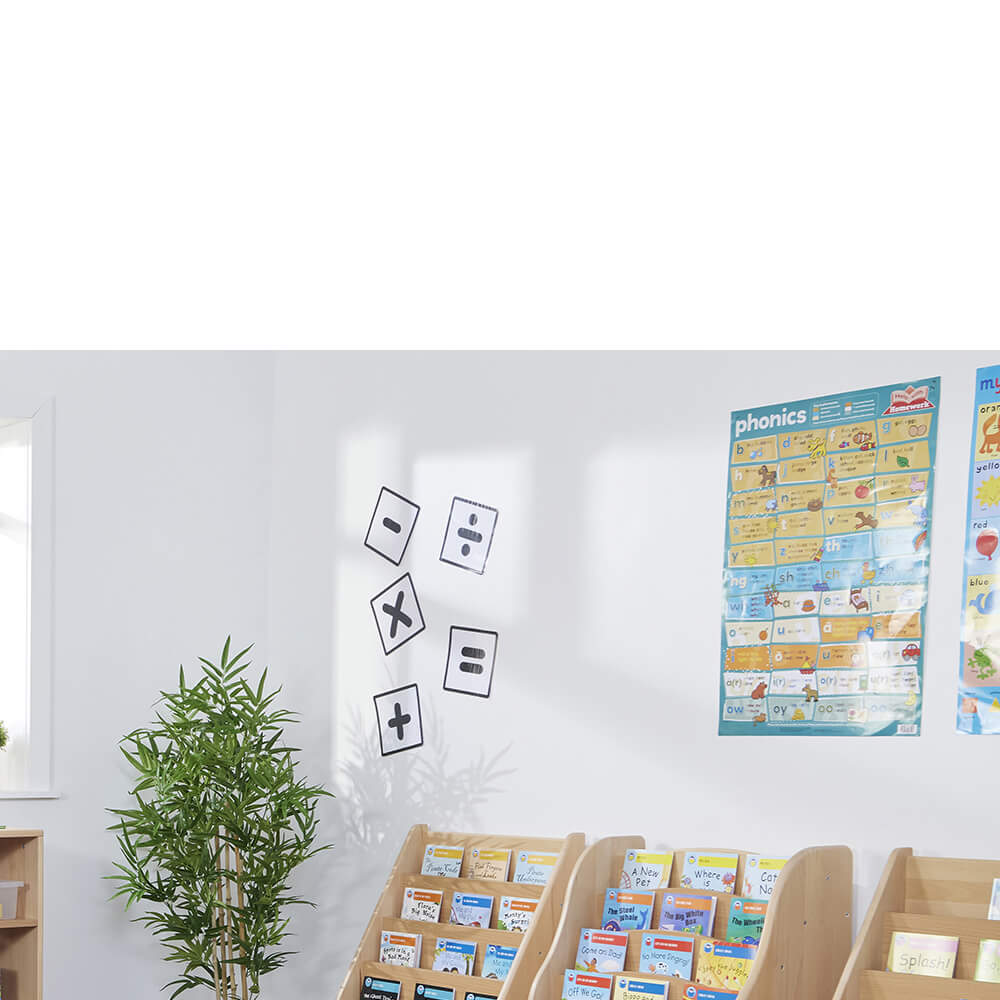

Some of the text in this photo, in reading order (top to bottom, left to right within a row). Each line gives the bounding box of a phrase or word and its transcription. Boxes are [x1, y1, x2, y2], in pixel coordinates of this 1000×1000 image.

[735, 407, 807, 438] phonics
[782, 435, 791, 448] d
[736, 442, 744, 455] b
[976, 461, 1000, 474] yello
[781, 494, 789, 503] n
[827, 517, 835, 525] v
[973, 520, 988, 529] red
[825, 539, 841, 552] th
[731, 552, 739, 563] y
[779, 571, 794, 582] sh
[825, 567, 840, 580] ch
[729, 576, 747, 589] ng
[969, 578, 989, 587] blue
[783, 600, 791, 608] a
[729, 629, 736, 637] o
[777, 627, 785, 635] u
[726, 705, 744, 714] ow
[773, 705, 787, 716] oy
[631, 866, 659, 878] A New
[694, 870, 721, 880] Where
[635, 877, 651, 887] Pet
[703, 878, 710, 887] is
[607, 907, 618, 915] The
[664, 911, 674, 919] The
[731, 917, 742, 926] The
[899, 953, 951, 970] Splash!
[567, 986, 580, 998] Off
[581, 987, 590, 997] We
